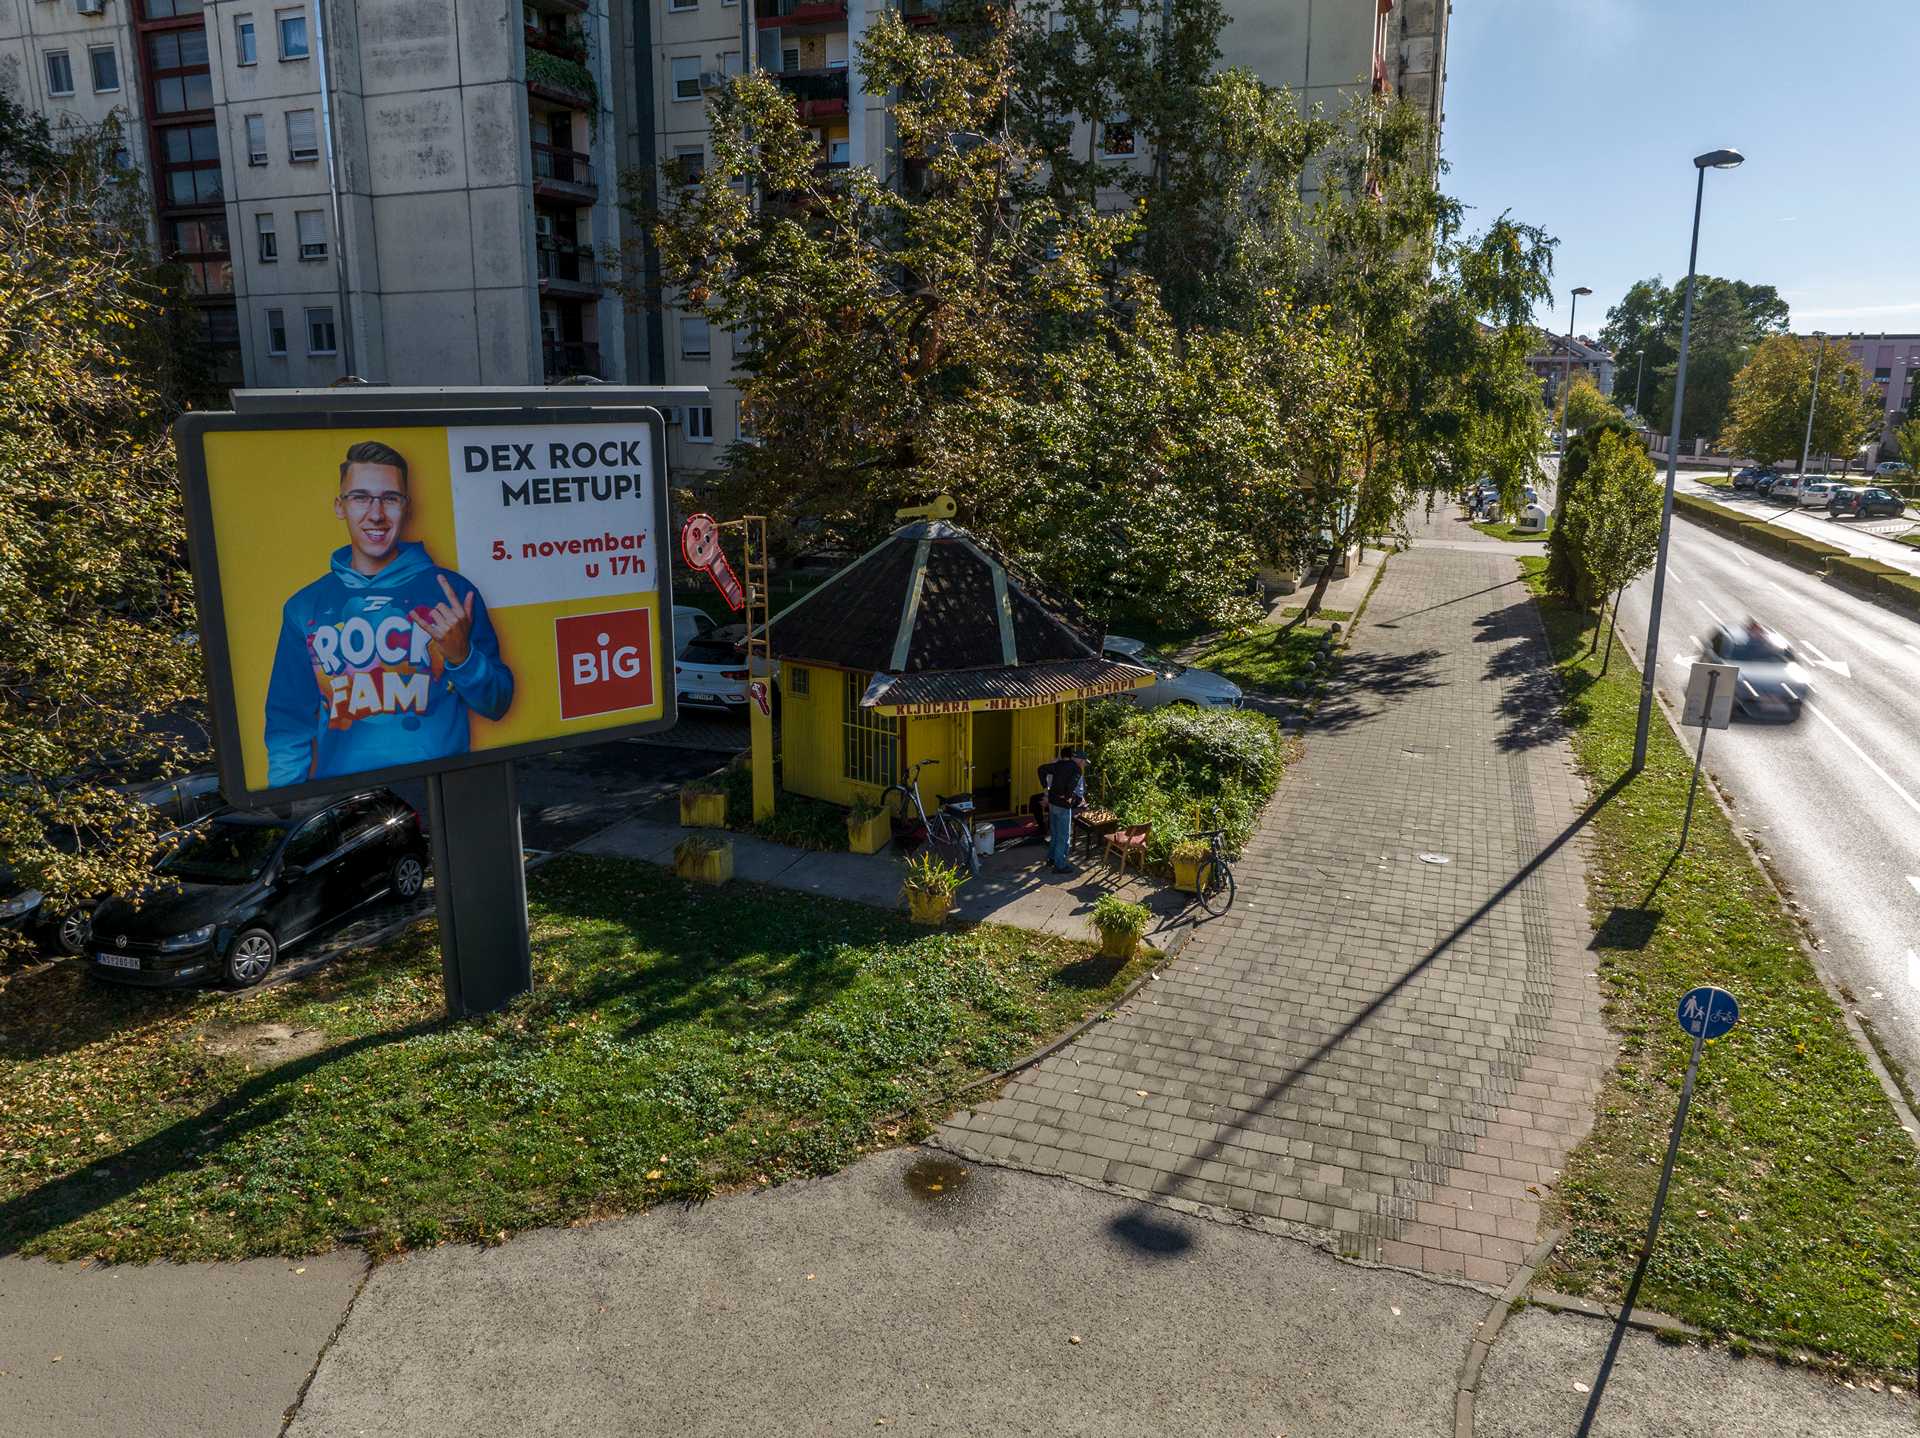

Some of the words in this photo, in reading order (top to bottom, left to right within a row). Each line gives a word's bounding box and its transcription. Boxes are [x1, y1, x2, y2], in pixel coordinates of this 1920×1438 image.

[463, 443, 536, 473] DEX
[549, 441, 642, 469] ROCK
[501, 474, 642, 507] MEETUP!
[492, 540, 513, 561] 5.
[522, 531, 647, 559] novembar
[585, 563, 600, 578] u
[609, 555, 646, 576] 17h
[312, 616, 433, 675] ROCK
[329, 671, 431, 720] FAM
